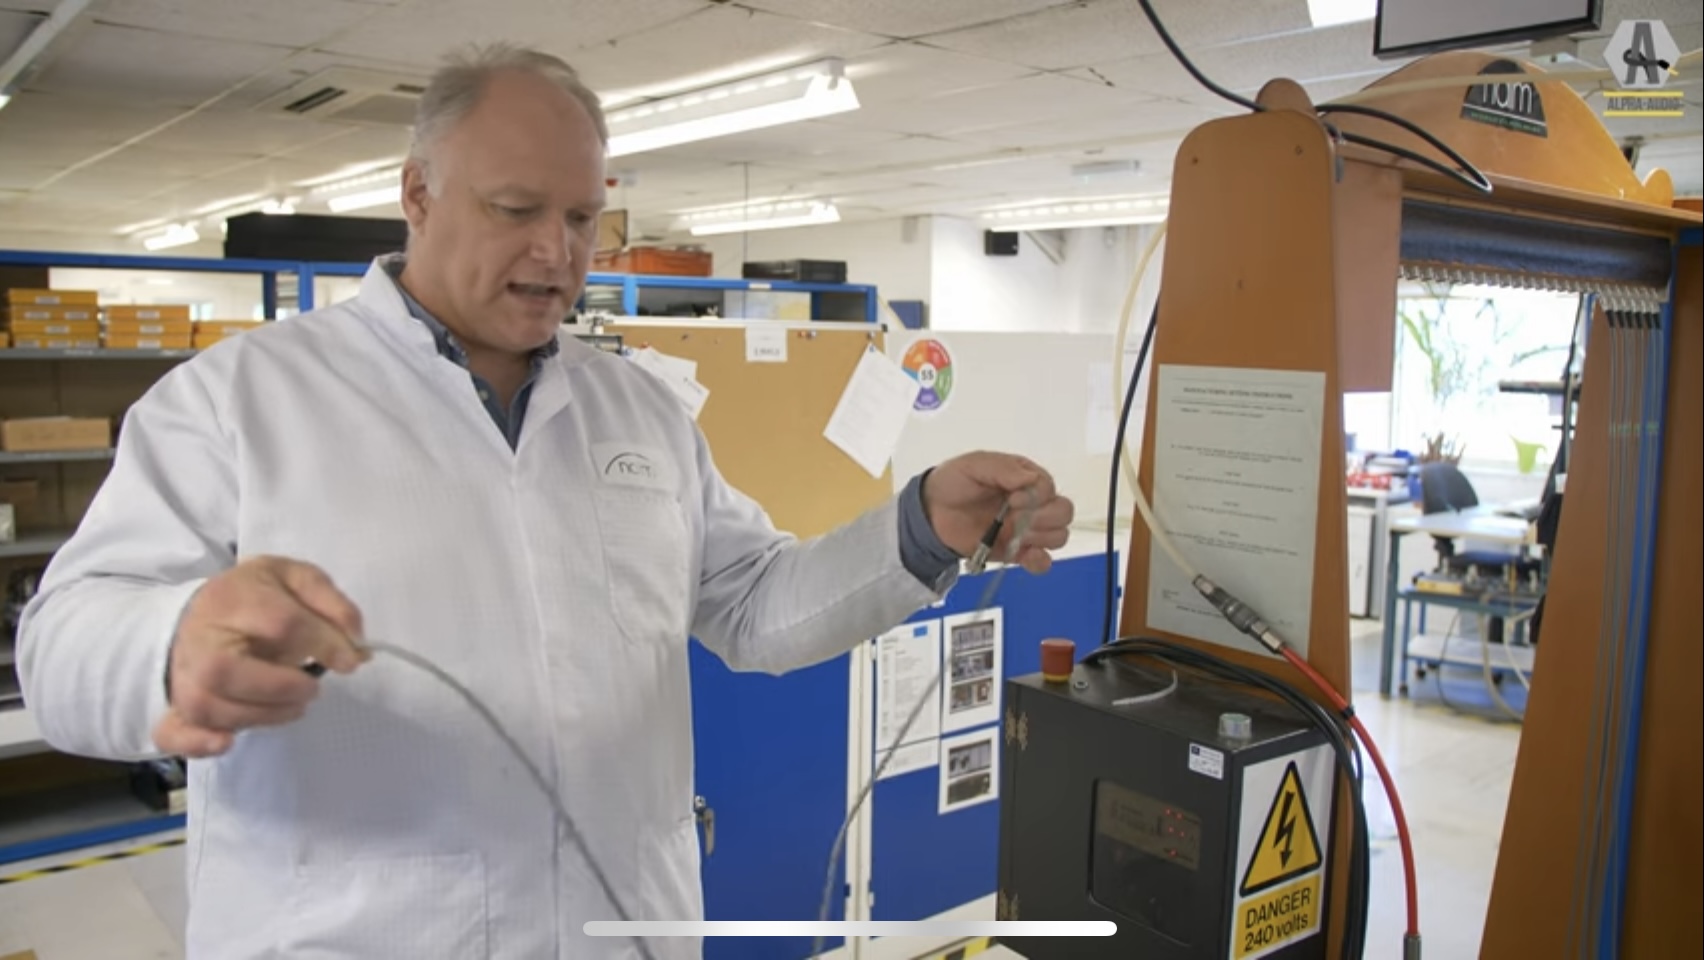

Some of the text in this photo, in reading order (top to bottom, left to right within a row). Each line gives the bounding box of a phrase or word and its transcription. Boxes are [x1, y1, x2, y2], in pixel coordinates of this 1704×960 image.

[1244, 887, 1311, 930] DANGER
[1244, 912, 1309, 953] 240 volts
